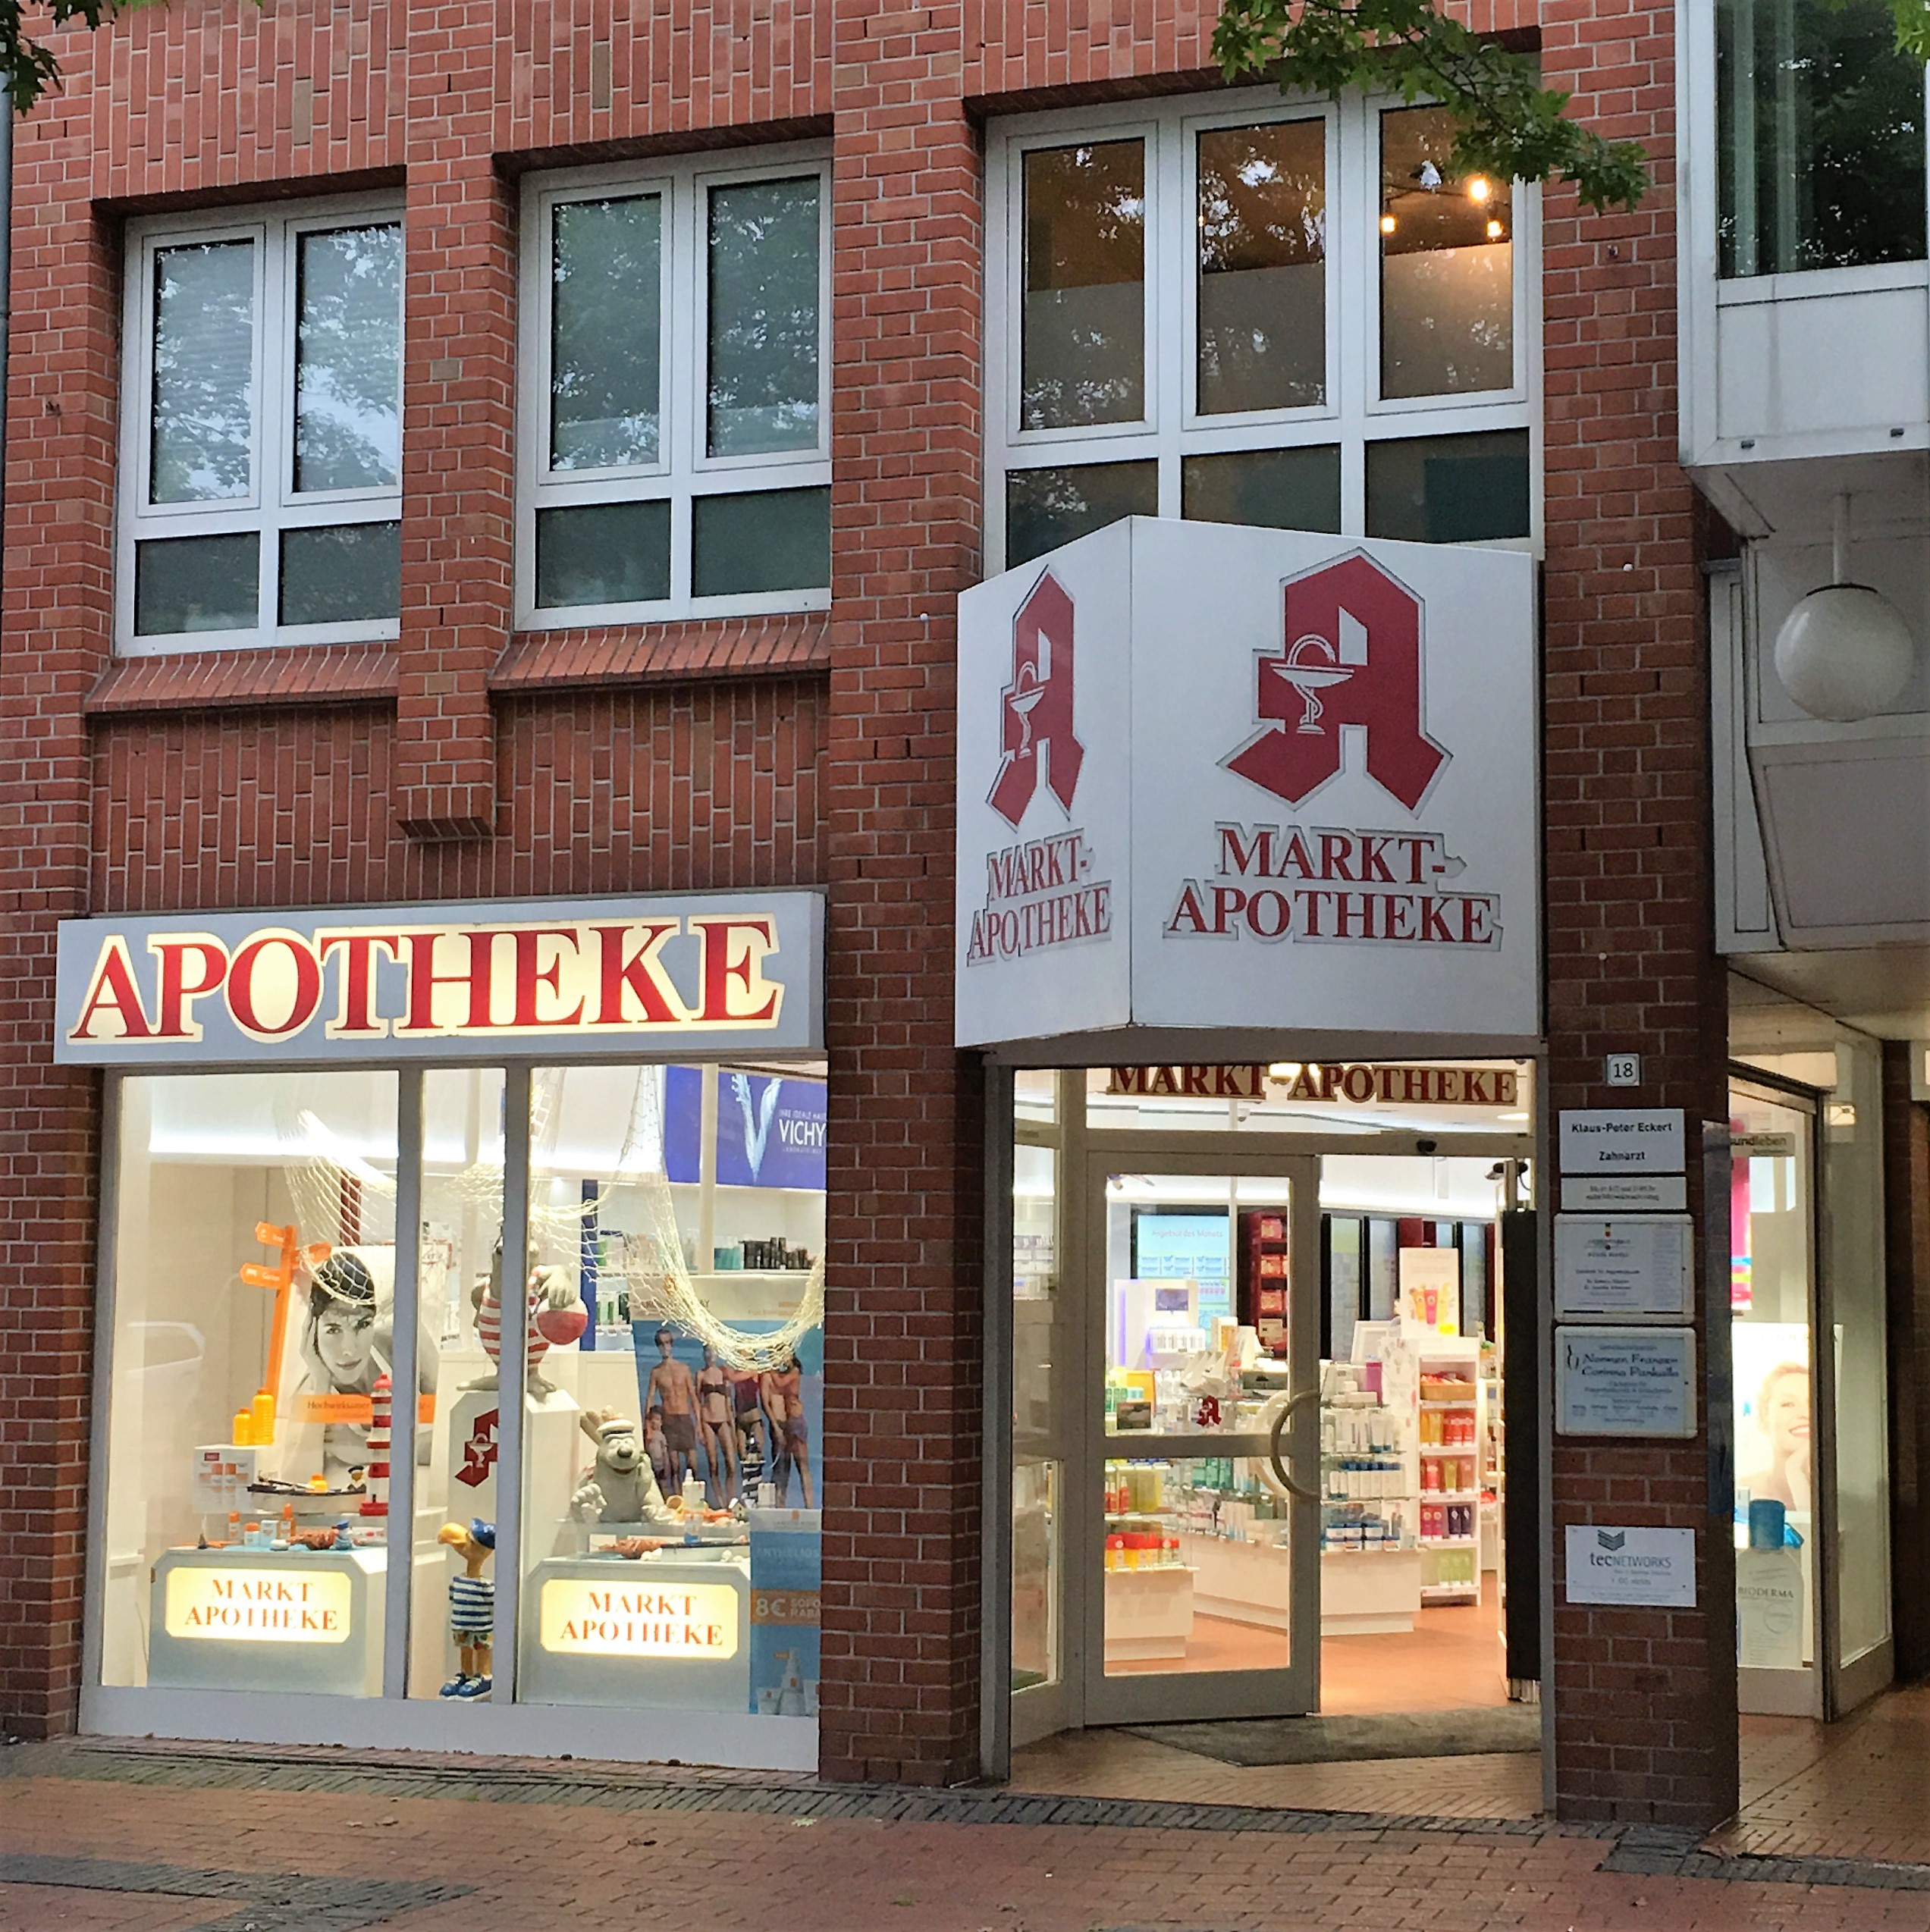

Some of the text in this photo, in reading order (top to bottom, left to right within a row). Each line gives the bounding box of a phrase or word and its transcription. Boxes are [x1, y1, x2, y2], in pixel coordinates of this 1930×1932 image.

[988, 835, 1088, 902] MARKT-
[1220, 828, 1446, 885] MARKT-
[968, 886, 1111, 961] APOTHEKE
[1166, 885, 1494, 945] APOTHEKE
[69, 920, 780, 1039] APOTHEKE
[1613, 1062, 1633, 1078] 18
[1110, 1065, 1517, 1105] MARKT APOTHEKE
[779, 1118, 827, 1147] VICHY
[1571, 1122, 1673, 1133] Klaus-Peter Eckert
[1599, 1151, 1646, 1162] Zahnarzt
[1590, 1553, 1672, 1569] tecNETWORKS
[212, 1579, 314, 1602] MARKT
[588, 1592, 698, 1617] MARKT
[755, 1597, 786, 1618] 8€
[184, 1606, 338, 1631] APOTHEKE
[560, 1619, 723, 1647] APOTHEKE
